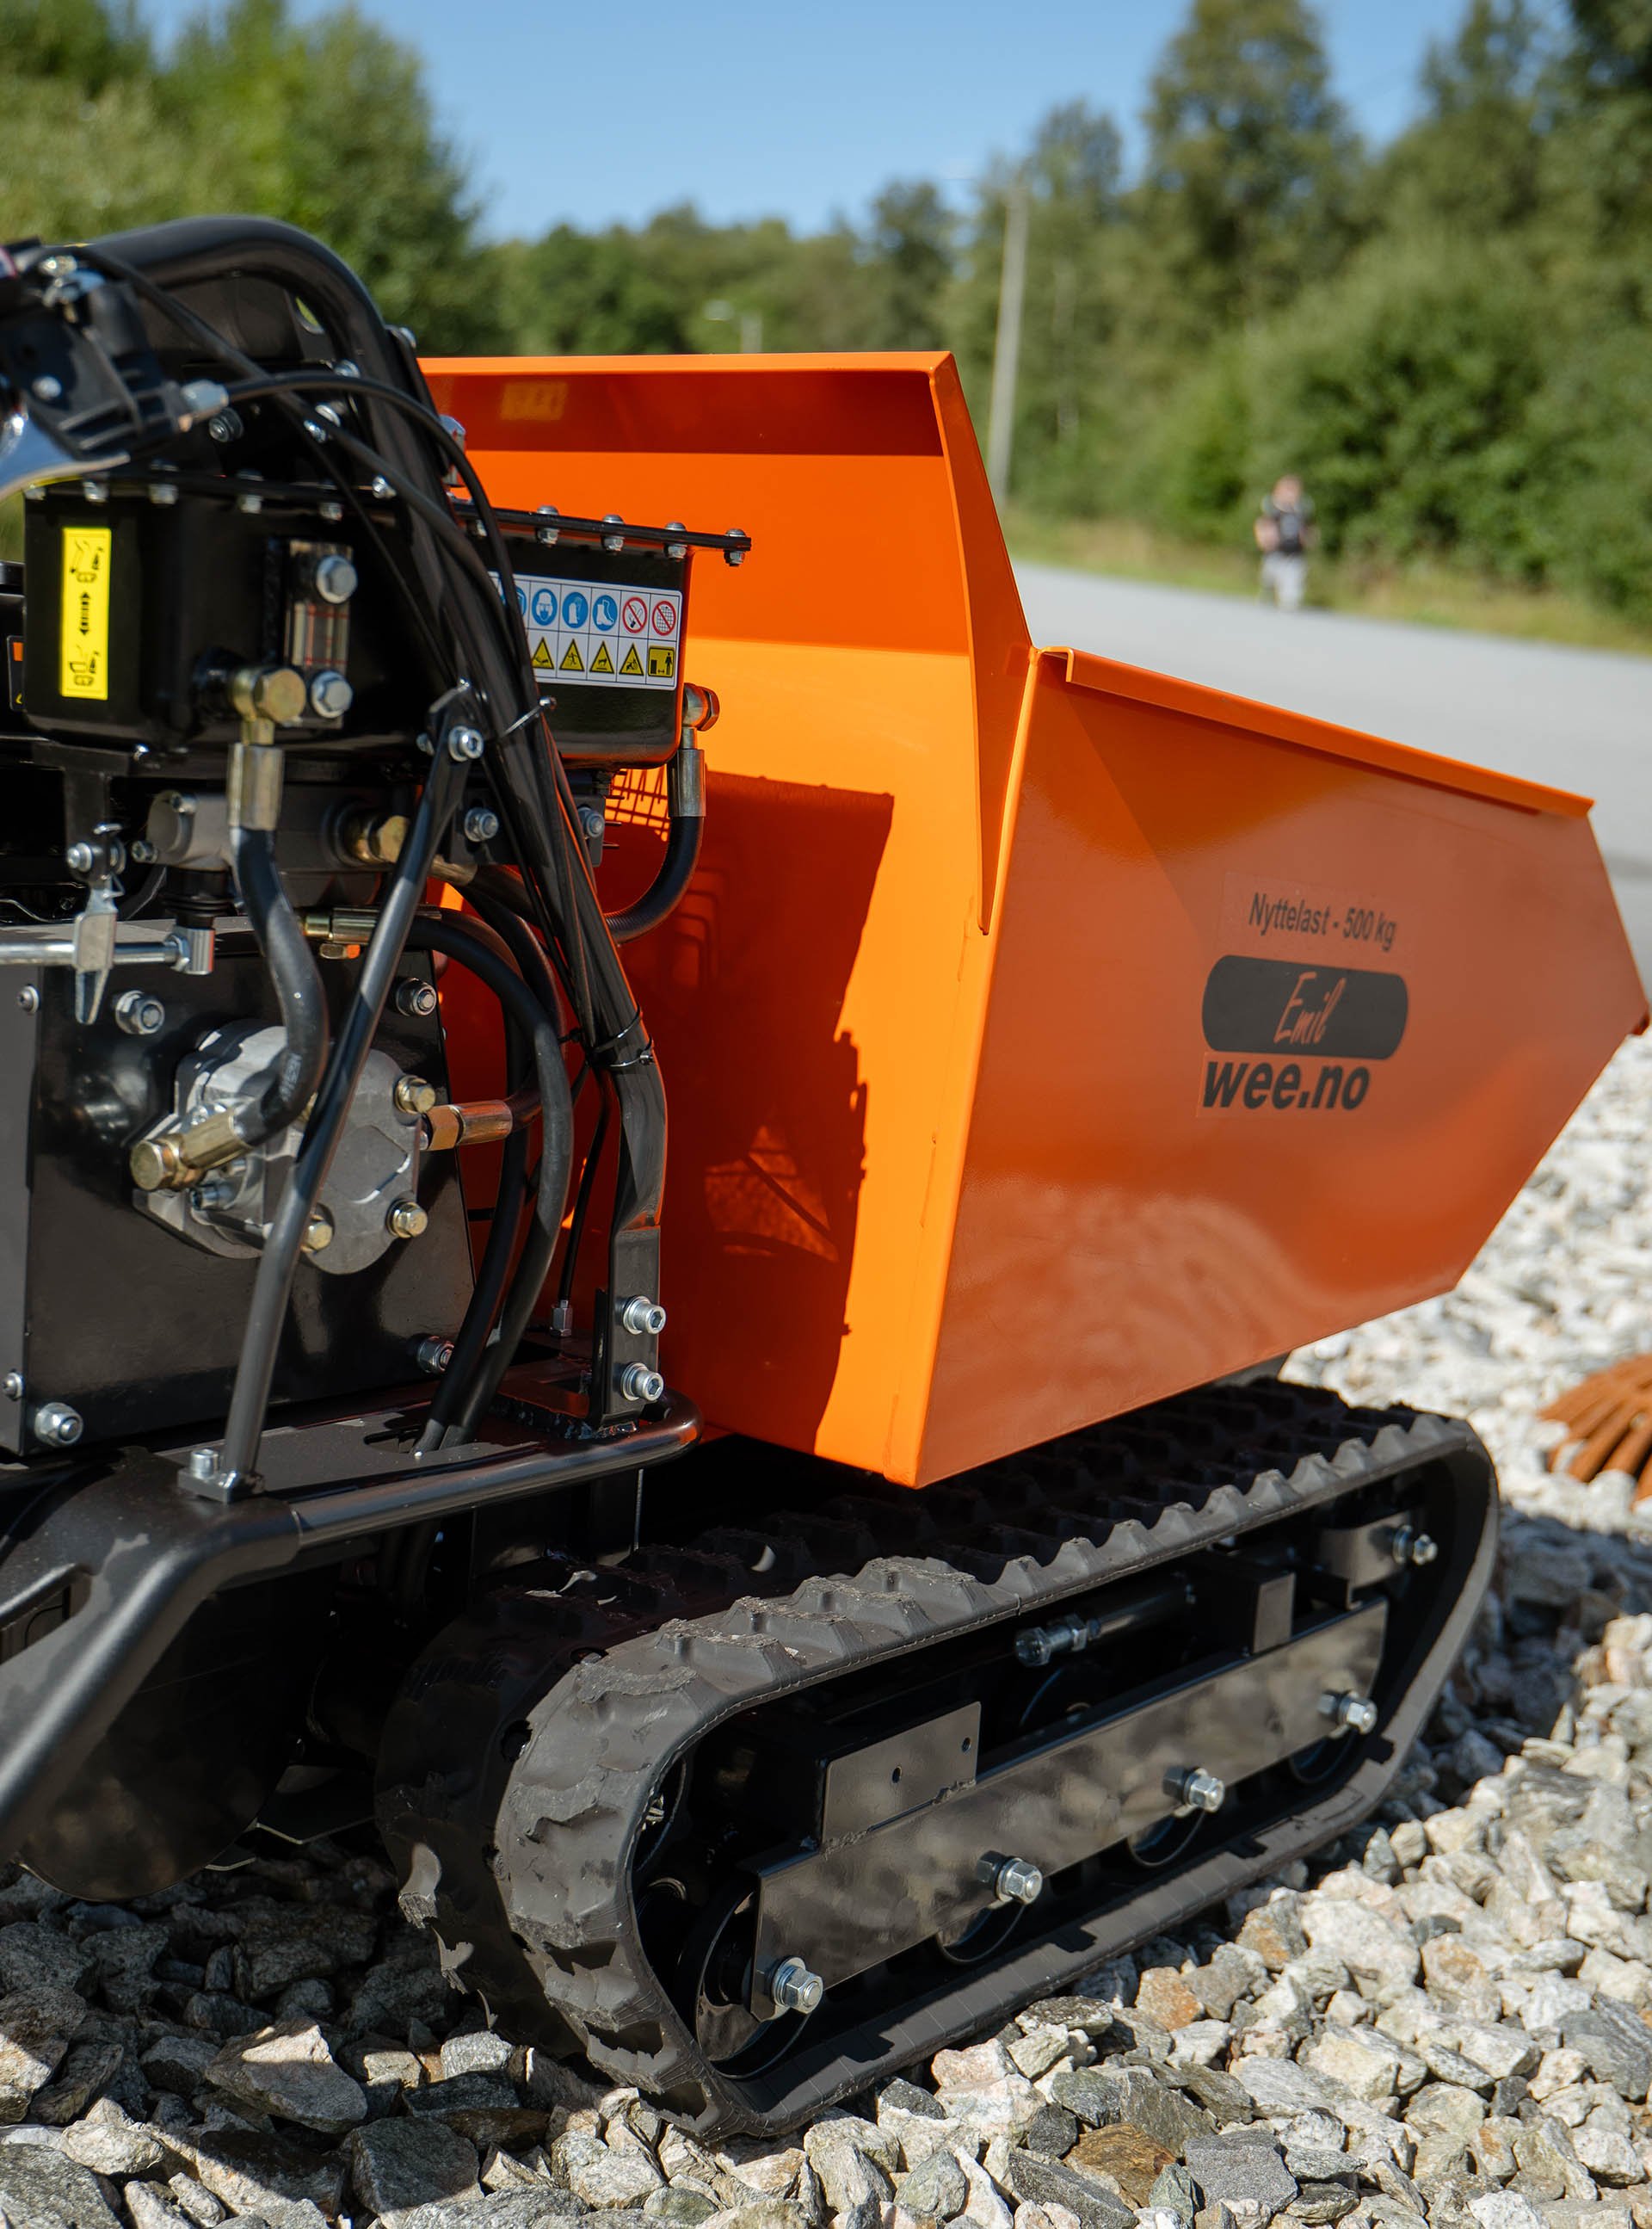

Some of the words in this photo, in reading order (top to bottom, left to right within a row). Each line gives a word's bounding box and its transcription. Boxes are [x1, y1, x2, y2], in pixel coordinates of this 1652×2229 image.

[1248, 892, 1330, 936] Nyttelast
[1343, 907, 1374, 941] 500
[1375, 912, 1396, 952] kg
[1273, 971, 1347, 1045] Emil
[1203, 1061, 1370, 1111] wee.no
